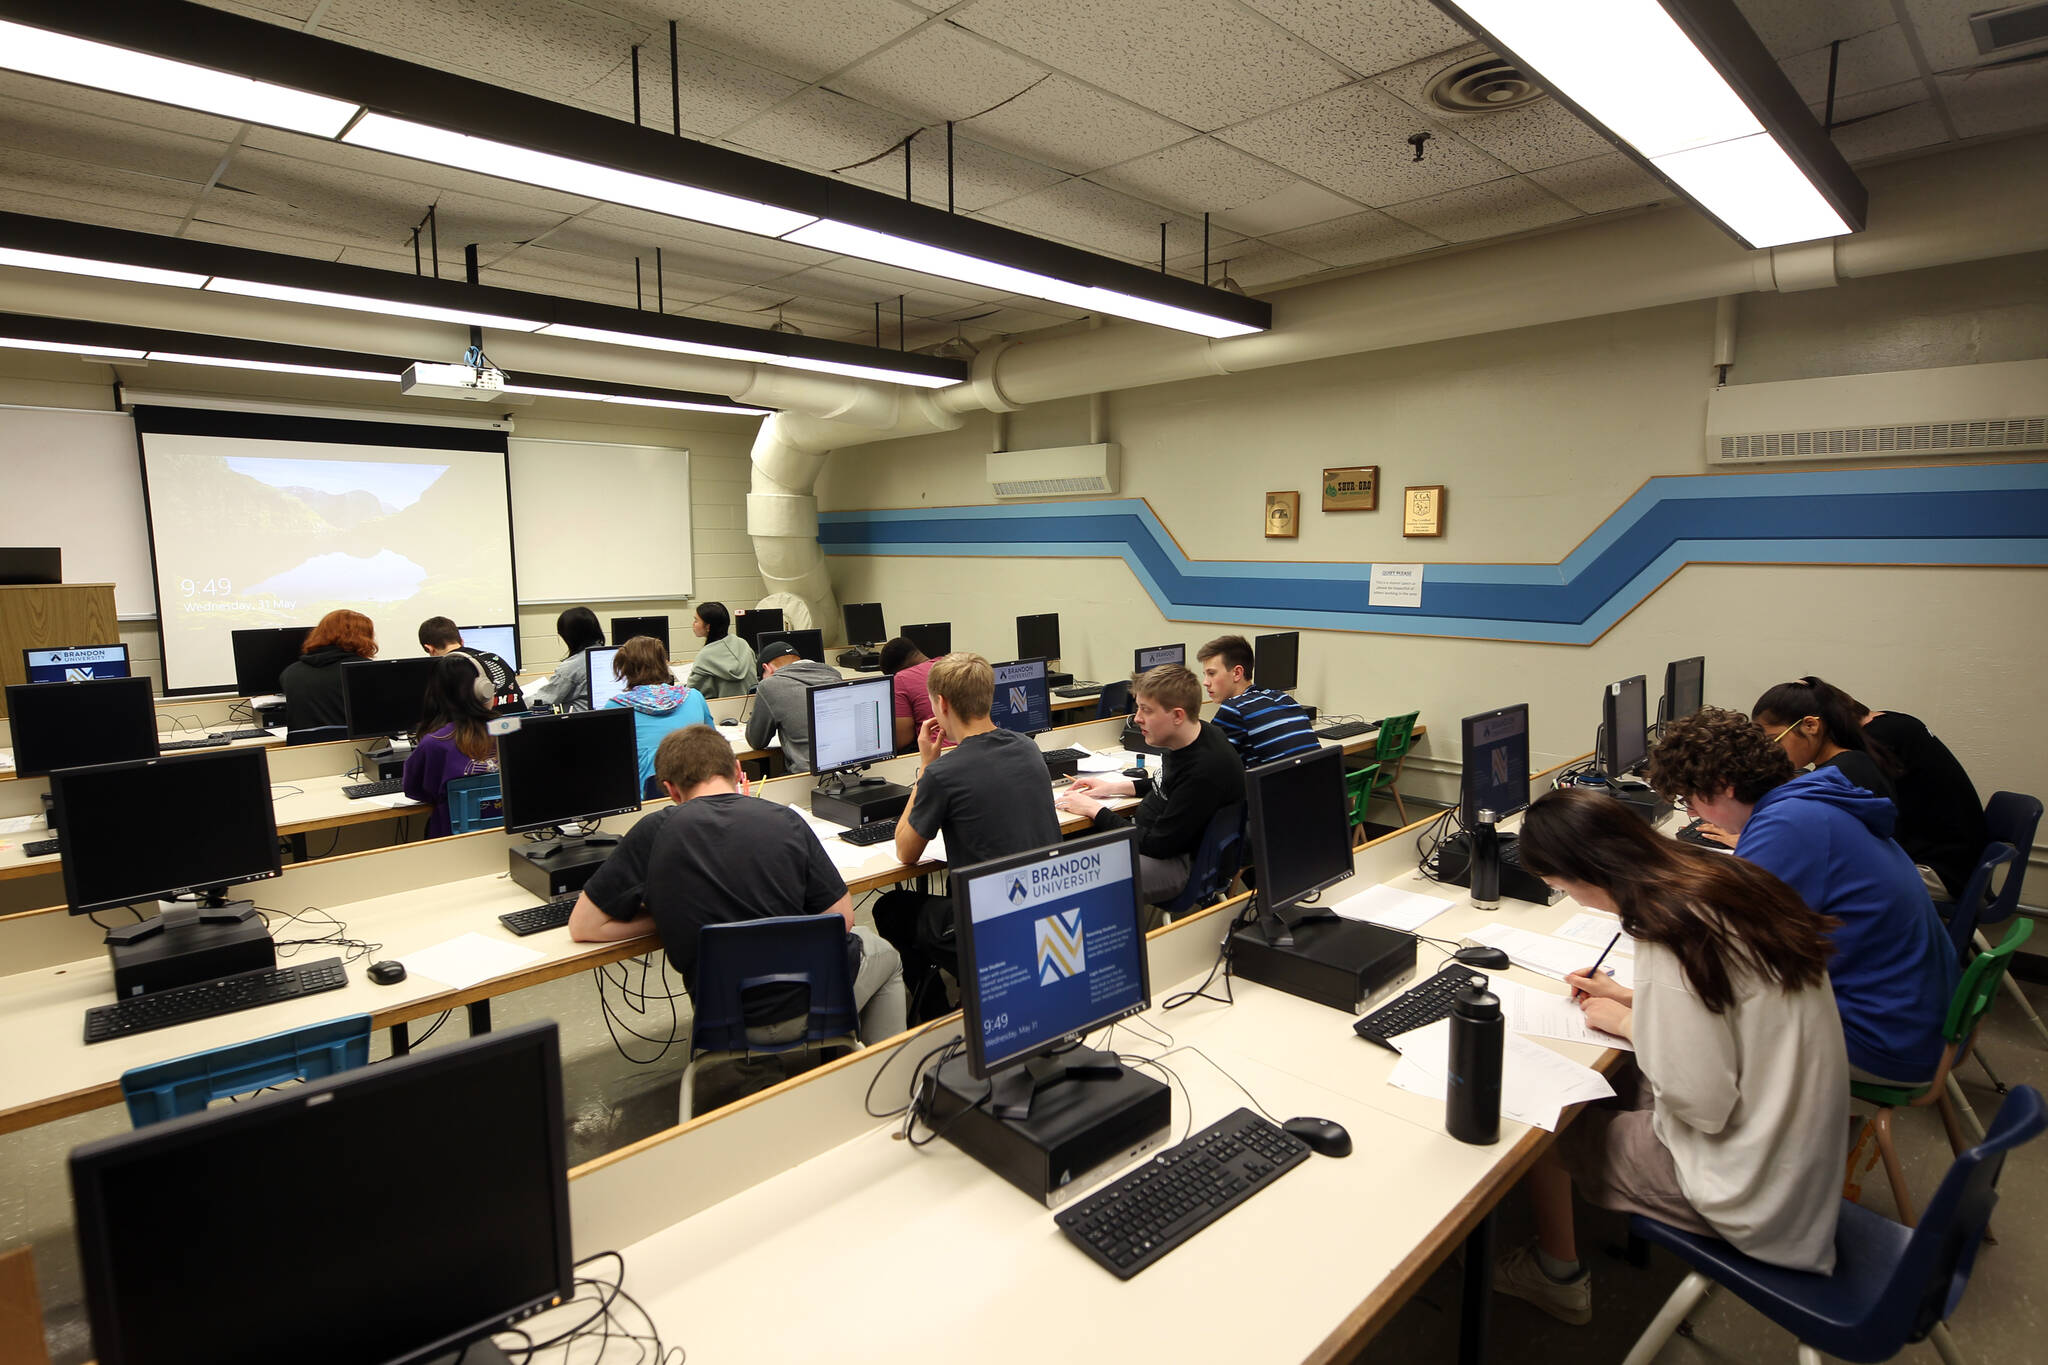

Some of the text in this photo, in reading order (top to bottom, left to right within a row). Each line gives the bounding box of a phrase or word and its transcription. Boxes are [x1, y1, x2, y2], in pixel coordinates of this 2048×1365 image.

[181, 577, 231, 598] 9:49
[258, 599, 270, 610] 31
[273, 599, 297, 611] May
[64, 650, 105, 658] BRANDON
[1032, 853, 1101, 884] BRANDON
[1033, 868, 1101, 898] UNIVERSITY
[983, 1012, 1009, 1035] 9:49
